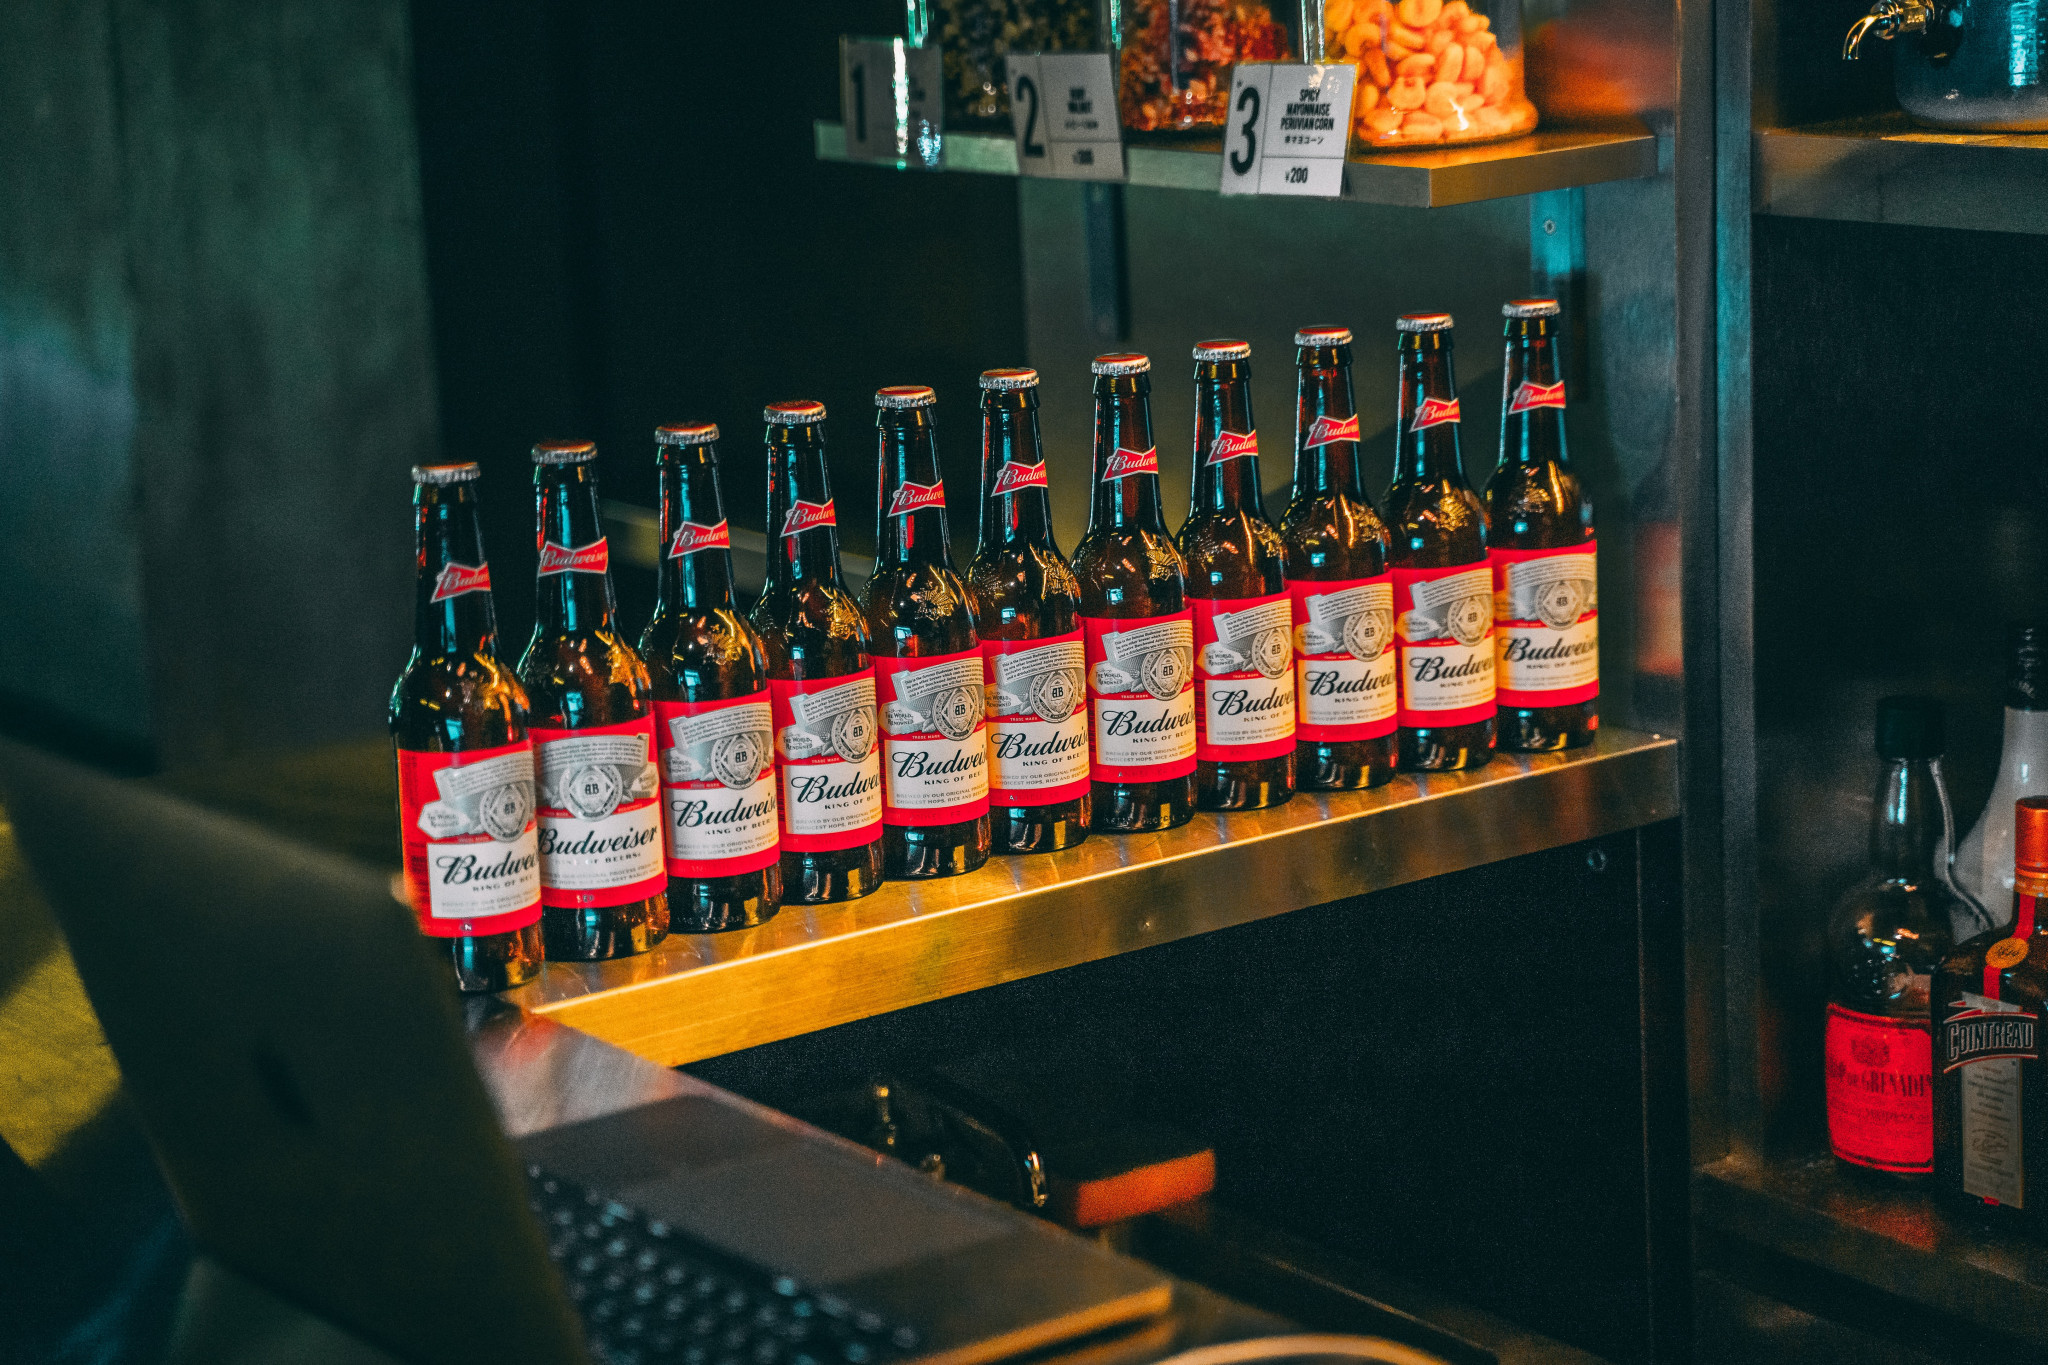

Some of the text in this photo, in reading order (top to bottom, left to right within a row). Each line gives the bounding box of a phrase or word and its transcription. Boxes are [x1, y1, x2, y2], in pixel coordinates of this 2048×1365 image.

[1299, 88, 1321, 102] SPICY
[853, 64, 866, 140] 1
[1286, 103, 1332, 116] MAYONNAISE
[1015, 76, 1045, 157] 2
[1280, 118, 1335, 130] PERUVIAN CORN
[1230, 87, 1260, 176] 3
[1285, 167, 1308, 183] ¥200
[1162, 664, 1174, 677] AB
[1052, 686, 1063, 699] AB
[954, 704, 966, 716] AB
[853, 725, 864, 737] AB
[735, 751, 747, 763] AB
[1022, 759, 1048, 767] KING
[1043, 770, 1069, 778] ORIGINAL
[584, 783, 600, 795] AB
[824, 802, 849, 810] KING
[538, 825, 657, 855] Budweiser
[1947, 1022, 2034, 1062] COINTREAU
